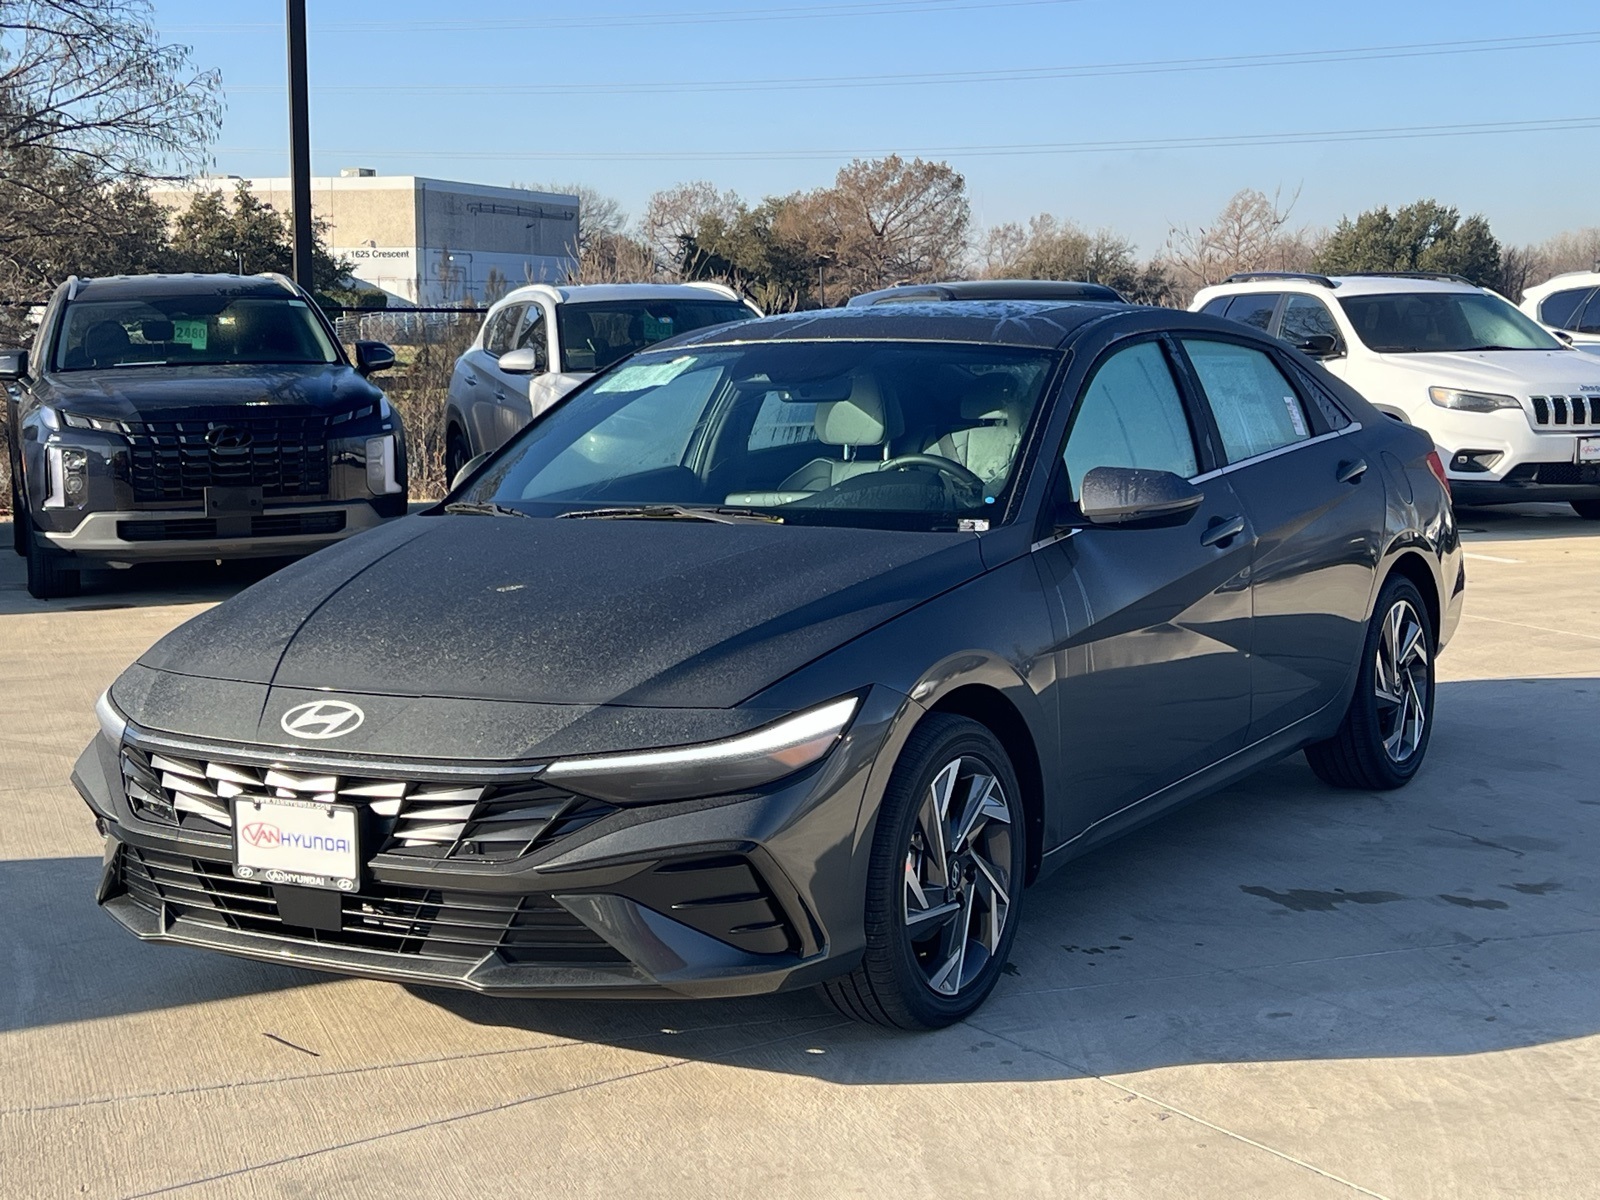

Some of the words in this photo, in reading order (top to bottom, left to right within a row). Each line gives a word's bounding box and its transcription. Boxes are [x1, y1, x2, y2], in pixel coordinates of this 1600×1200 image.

[351, 250, 370, 258] 1625
[372, 250, 409, 258] Crescent
[175, 327, 205, 339] 2480
